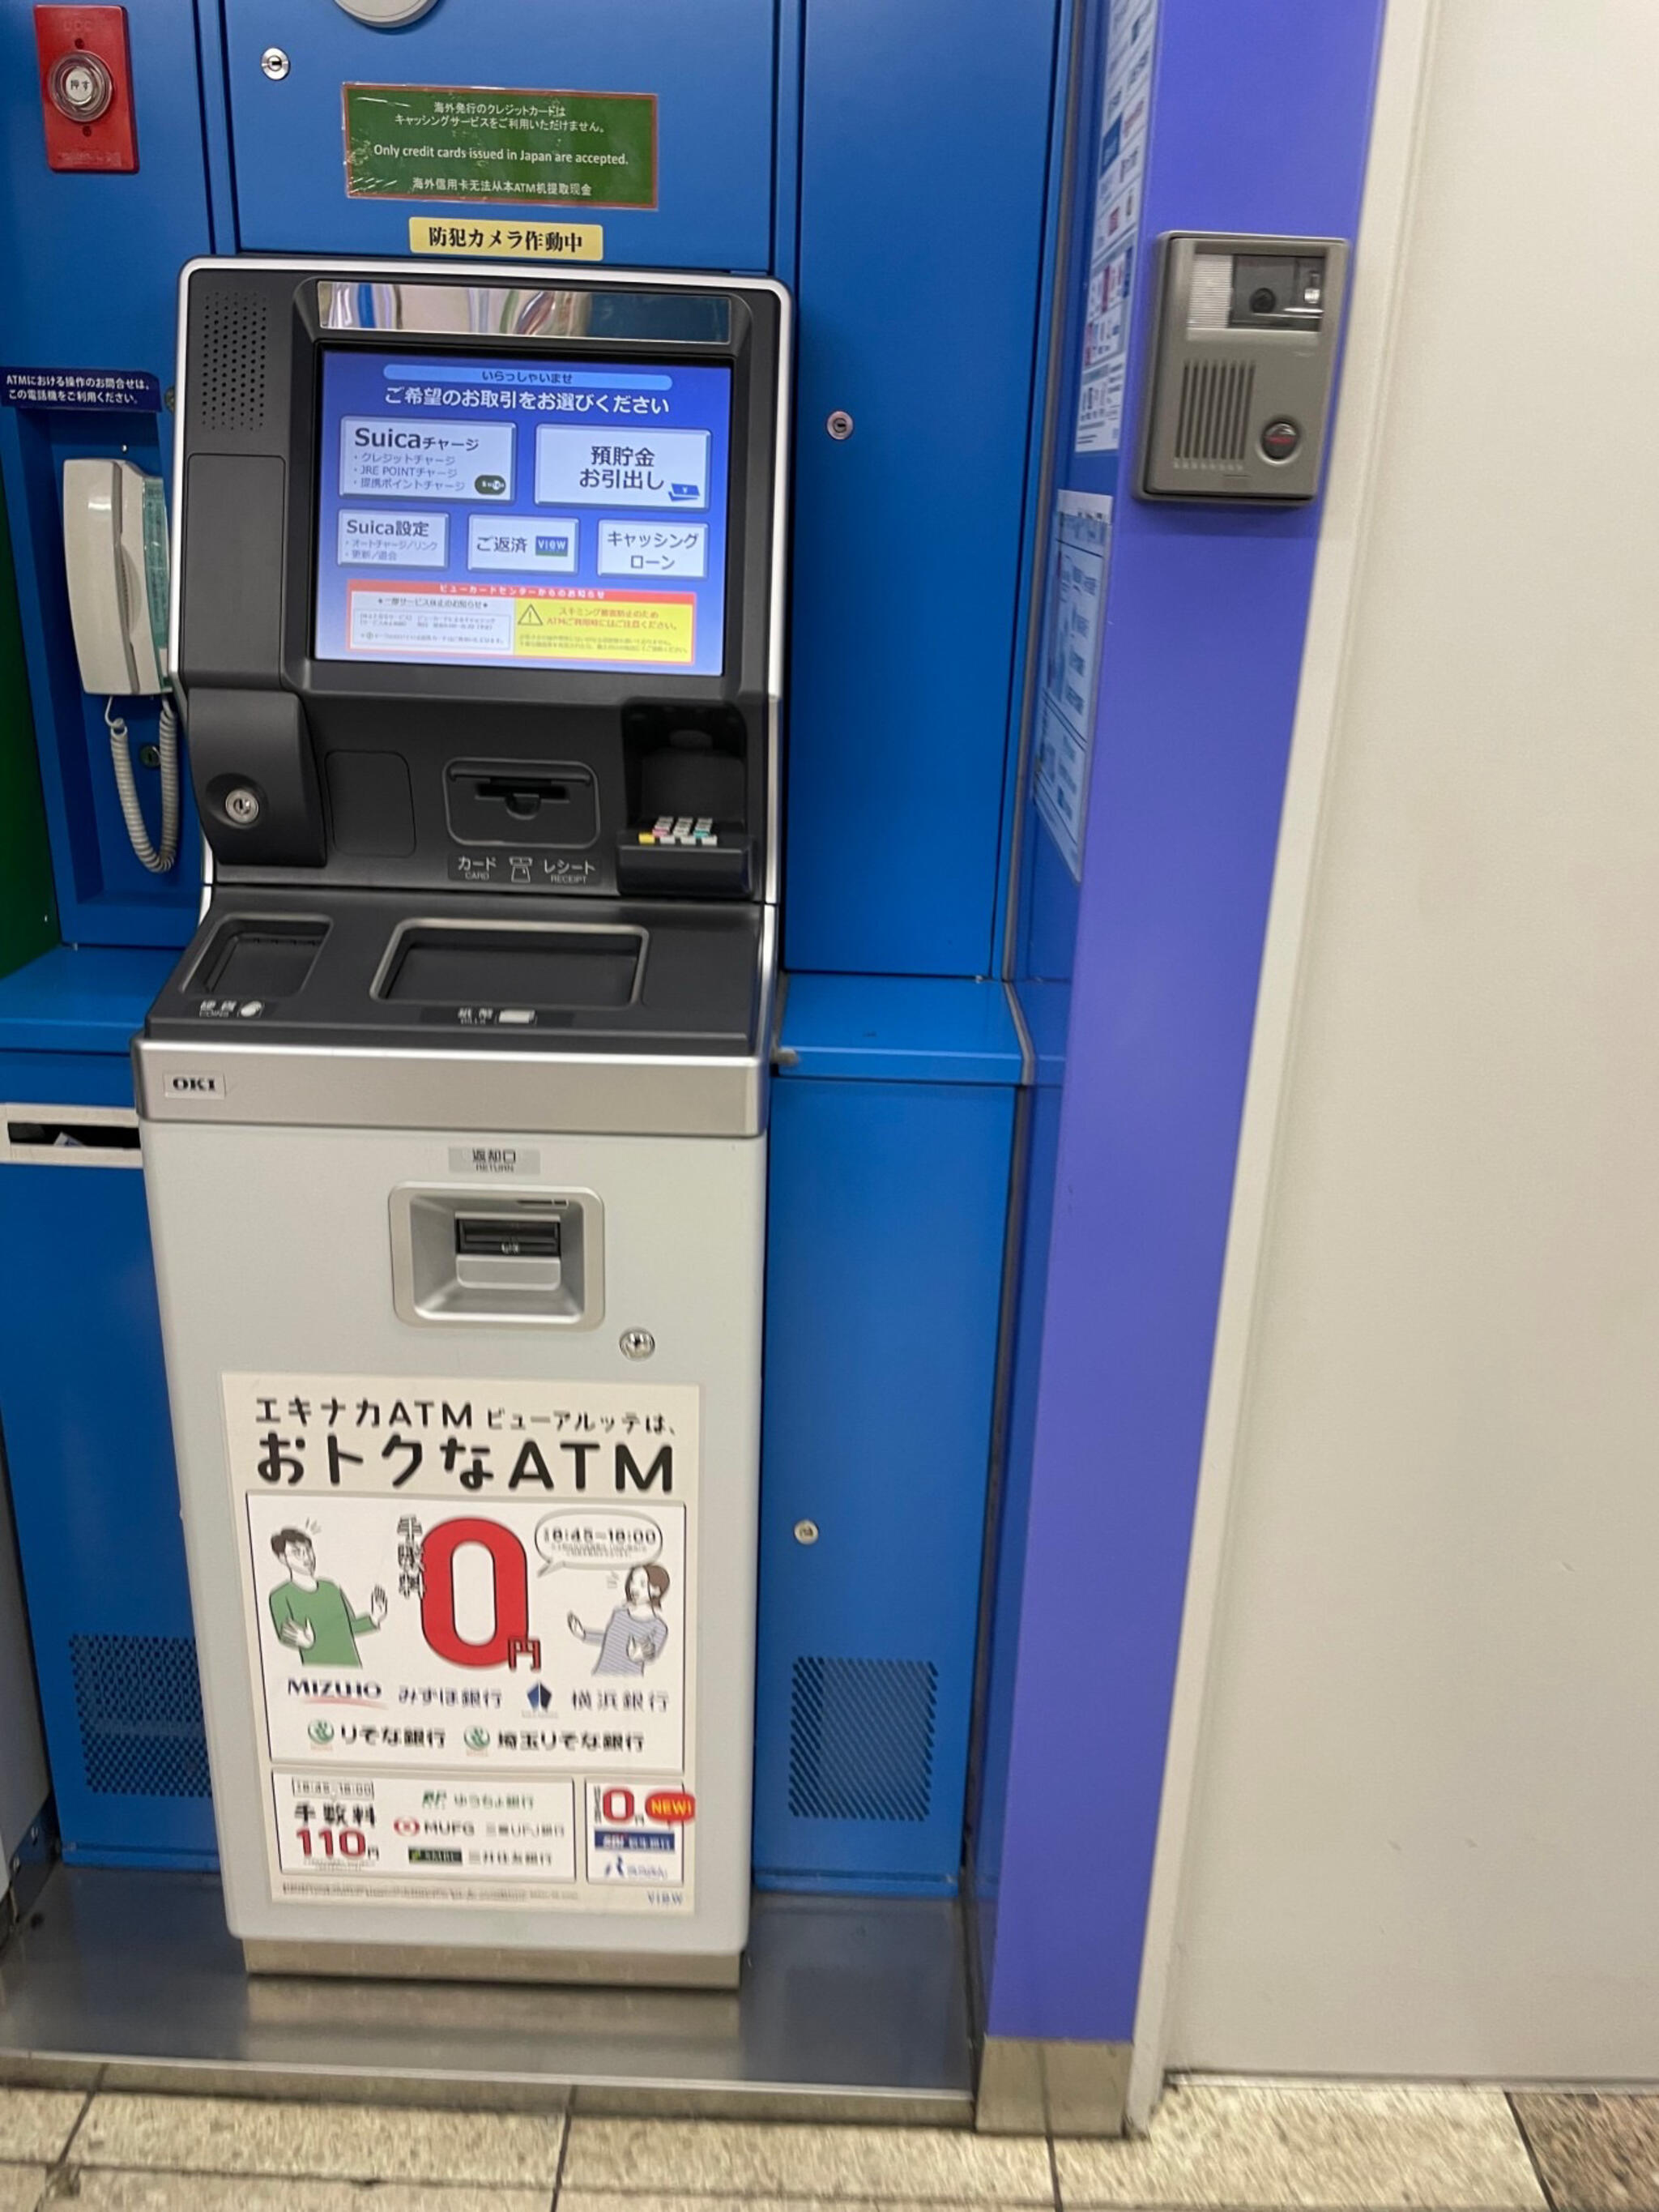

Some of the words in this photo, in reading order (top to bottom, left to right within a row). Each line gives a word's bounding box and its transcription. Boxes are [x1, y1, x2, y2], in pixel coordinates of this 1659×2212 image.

[434, 102, 565, 117] 海外発行のクレジットカードは
[394, 114, 606, 134] キャッシングサービスをご利用いただけません。
[374, 144, 399, 159] Only
[402, 145, 434, 158] credit
[437, 147, 467, 159] cards
[469, 147, 503, 160] issued
[506, 148, 517, 160] in
[520, 150, 552, 164] Japan
[555, 152, 573, 163] are
[575, 151, 629, 166] accepted.
[412, 177, 592, 196] 海外信用卡无法从本ATM机提取现金
[429, 227, 582, 254] 防犯カメラ作動中
[482, 369, 573, 385] いらっしゃいませ
[9, 389, 138, 404] この電話機をご利用ください。
[386, 386, 669, 414] ご希望のお取引をお選びください
[355, 428, 479, 451] Suicaチャージ
[591, 446, 655, 468] 預貯金
[360, 466, 378, 476] JRE
[579, 468, 664, 490] お引出し
[347, 519, 429, 536] Suica設定
[477, 536, 527, 554] ご返済
[608, 531, 698, 549] キャッシング
[630, 555, 675, 570] ローン
[458, 856, 497, 871] カード
[544, 859, 595, 875] レシート
[173, 1077, 215, 1091] OKI
[255, 1397, 473, 1428] エキナカATM
[487, 1407, 676, 1436] ビューアルッテは、
[257, 1432, 674, 1493] おトクなATM
[341, 1723, 446, 1749] りそな銀行
